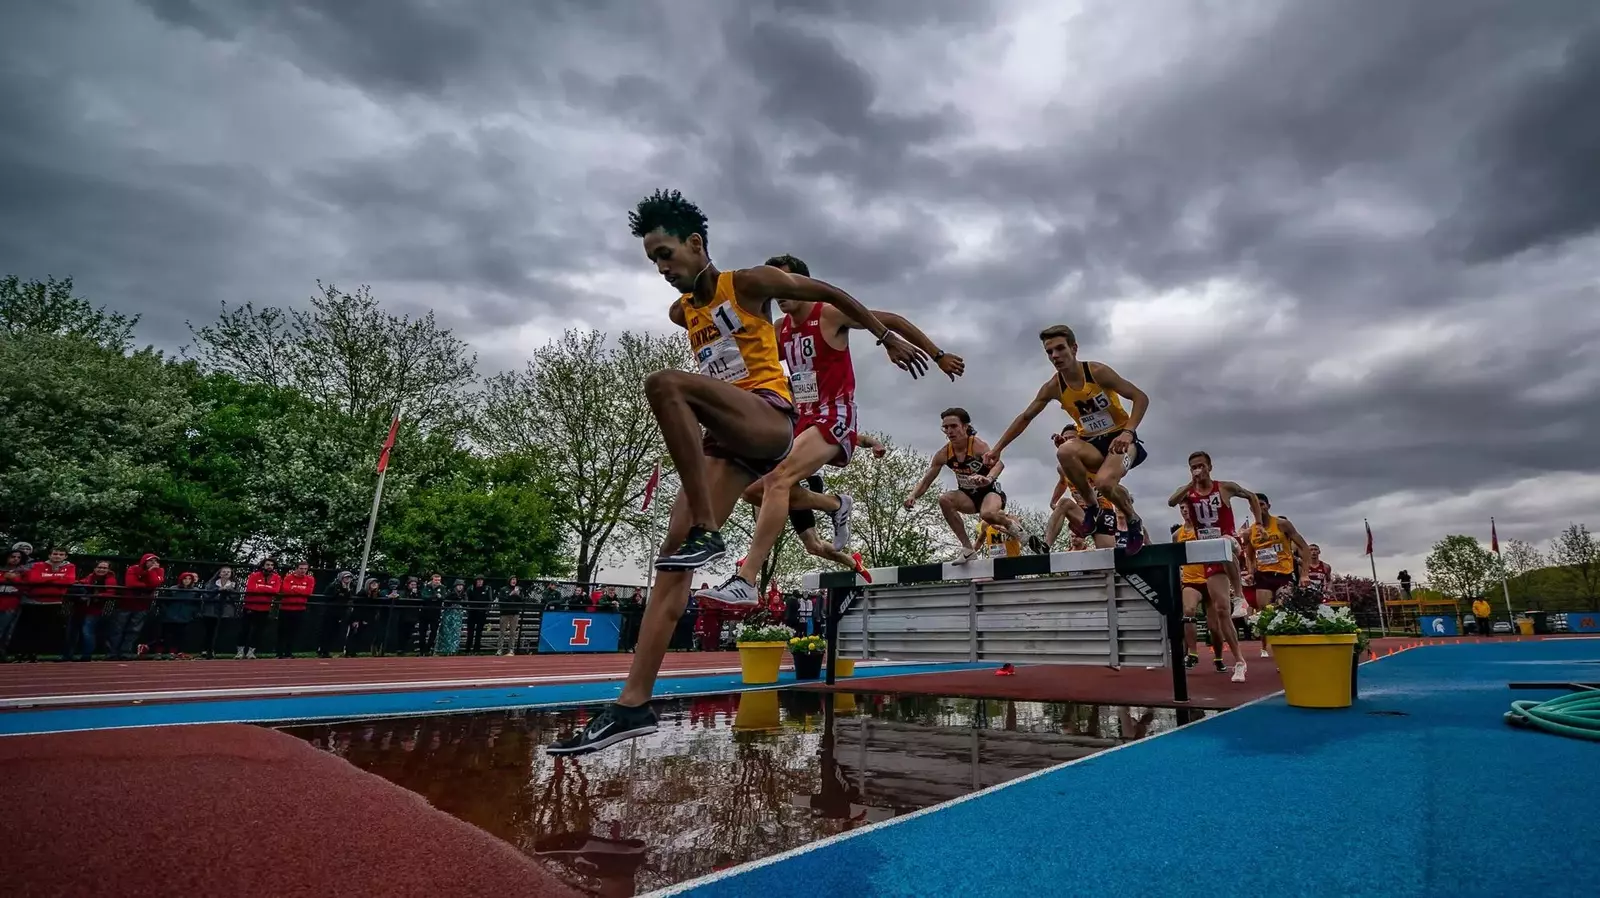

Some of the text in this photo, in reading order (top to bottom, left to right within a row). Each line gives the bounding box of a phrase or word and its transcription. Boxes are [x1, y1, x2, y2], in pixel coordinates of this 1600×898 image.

[716, 306, 735, 331] 1
[803, 338, 813, 357] 8
[708, 357, 730, 378] ALI
[1095, 394, 1109, 408] 5
[1089, 419, 1108, 431] TATE
[1211, 496, 1220, 506] 4
[1125, 573, 1158, 601] GILL
[838, 590, 854, 613] GILL
[569, 618, 592, 646] I
